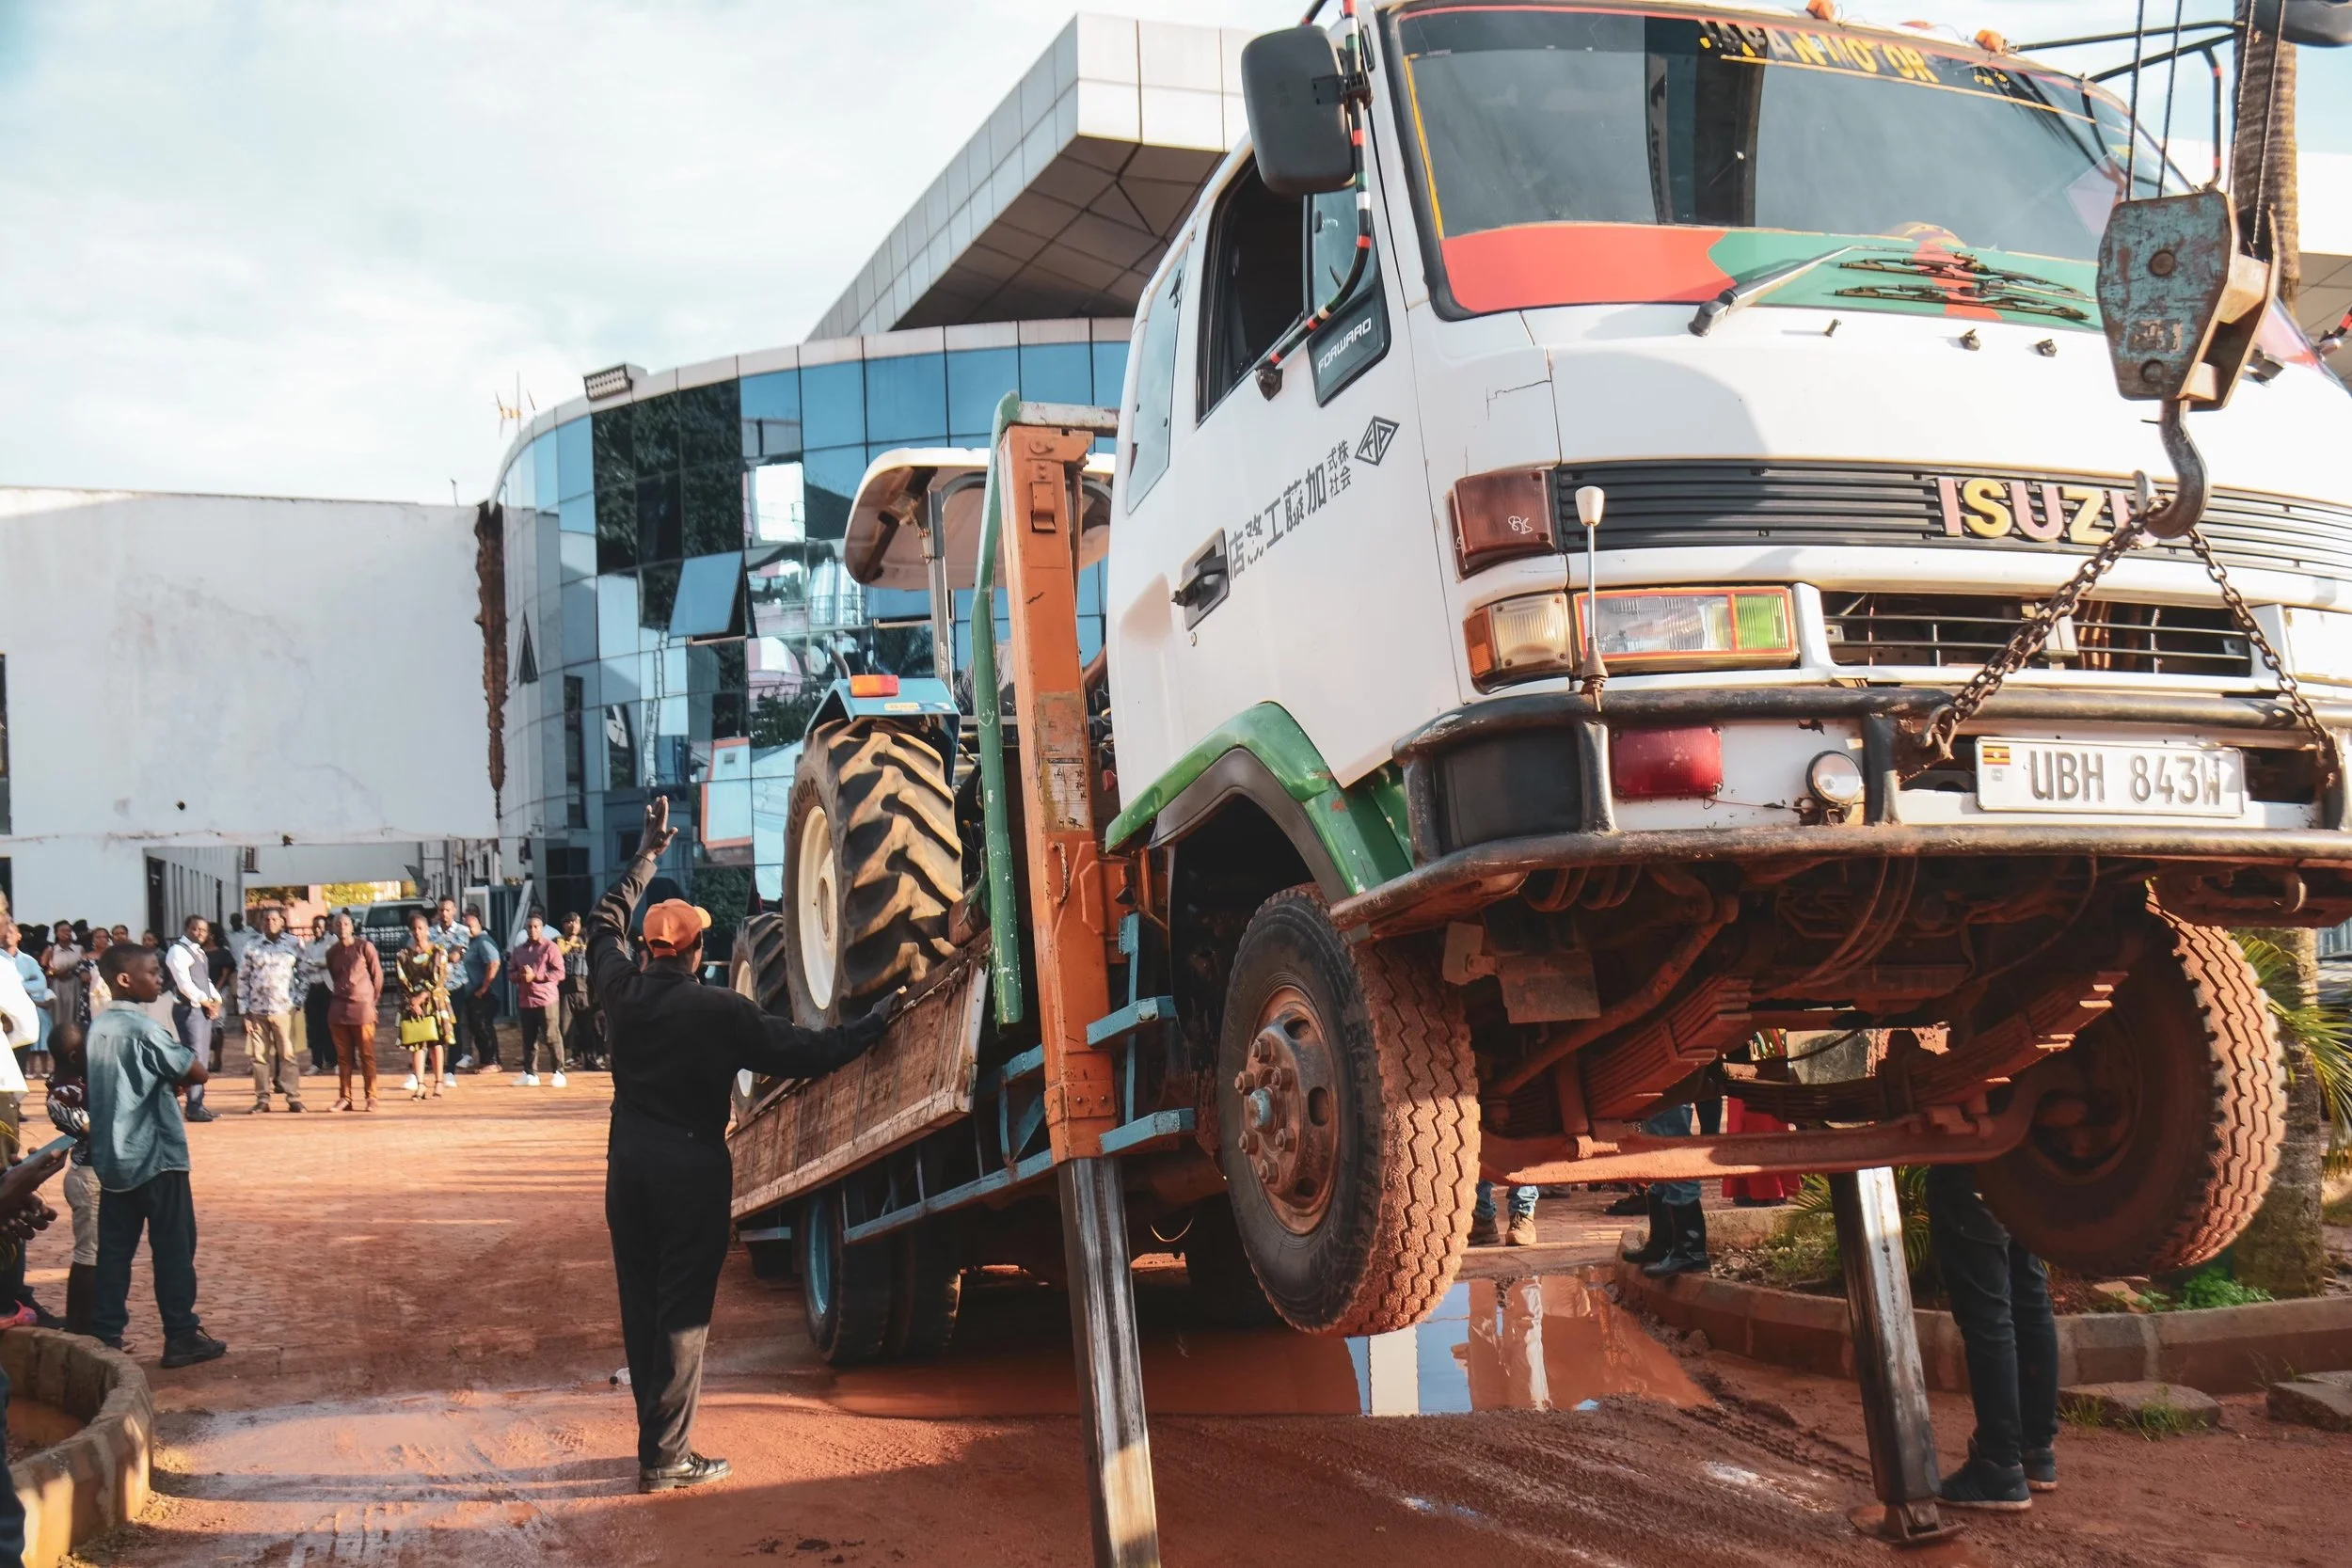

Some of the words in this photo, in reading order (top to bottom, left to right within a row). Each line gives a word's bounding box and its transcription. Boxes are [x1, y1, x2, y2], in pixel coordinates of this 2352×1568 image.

[1318, 317, 1372, 374] FORWARD
[2030, 751, 2106, 802] UBH
[2129, 754, 2220, 805] 843W
